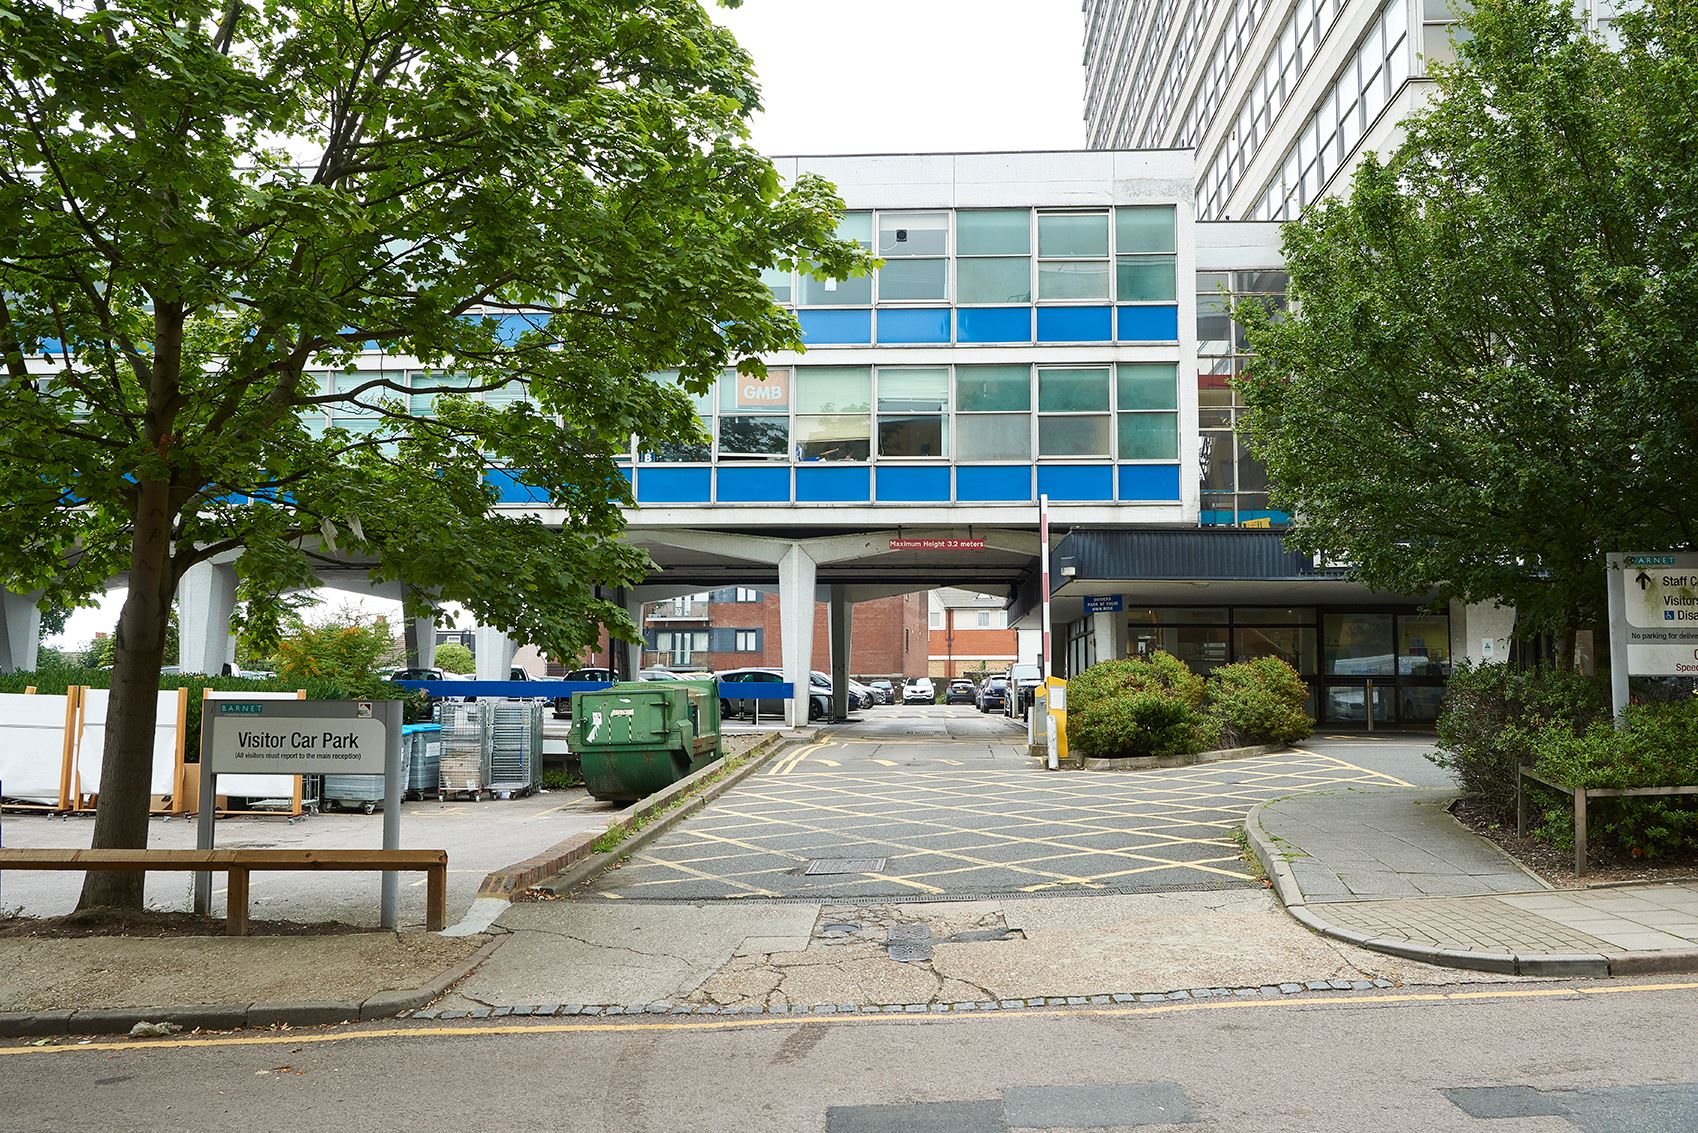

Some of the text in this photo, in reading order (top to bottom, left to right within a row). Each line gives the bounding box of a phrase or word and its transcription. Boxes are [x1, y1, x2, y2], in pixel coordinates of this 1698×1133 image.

[743, 384, 783, 400] GMB
[923, 540, 945, 548] Height
[1632, 556, 1674, 564] ARNET
[1662, 576, 1687, 586] Staff
[1677, 610, 1698, 621] Disa
[1631, 632, 1641, 640] No
[1642, 632, 1667, 641] parking
[1668, 632, 1678, 640] for
[221, 704, 263, 713] BARNET
[238, 731, 360, 749] Visitor Car Park
[235, 752, 244, 760] (All
[281, 752, 298, 761] report
[332, 753, 362, 761] reception)
